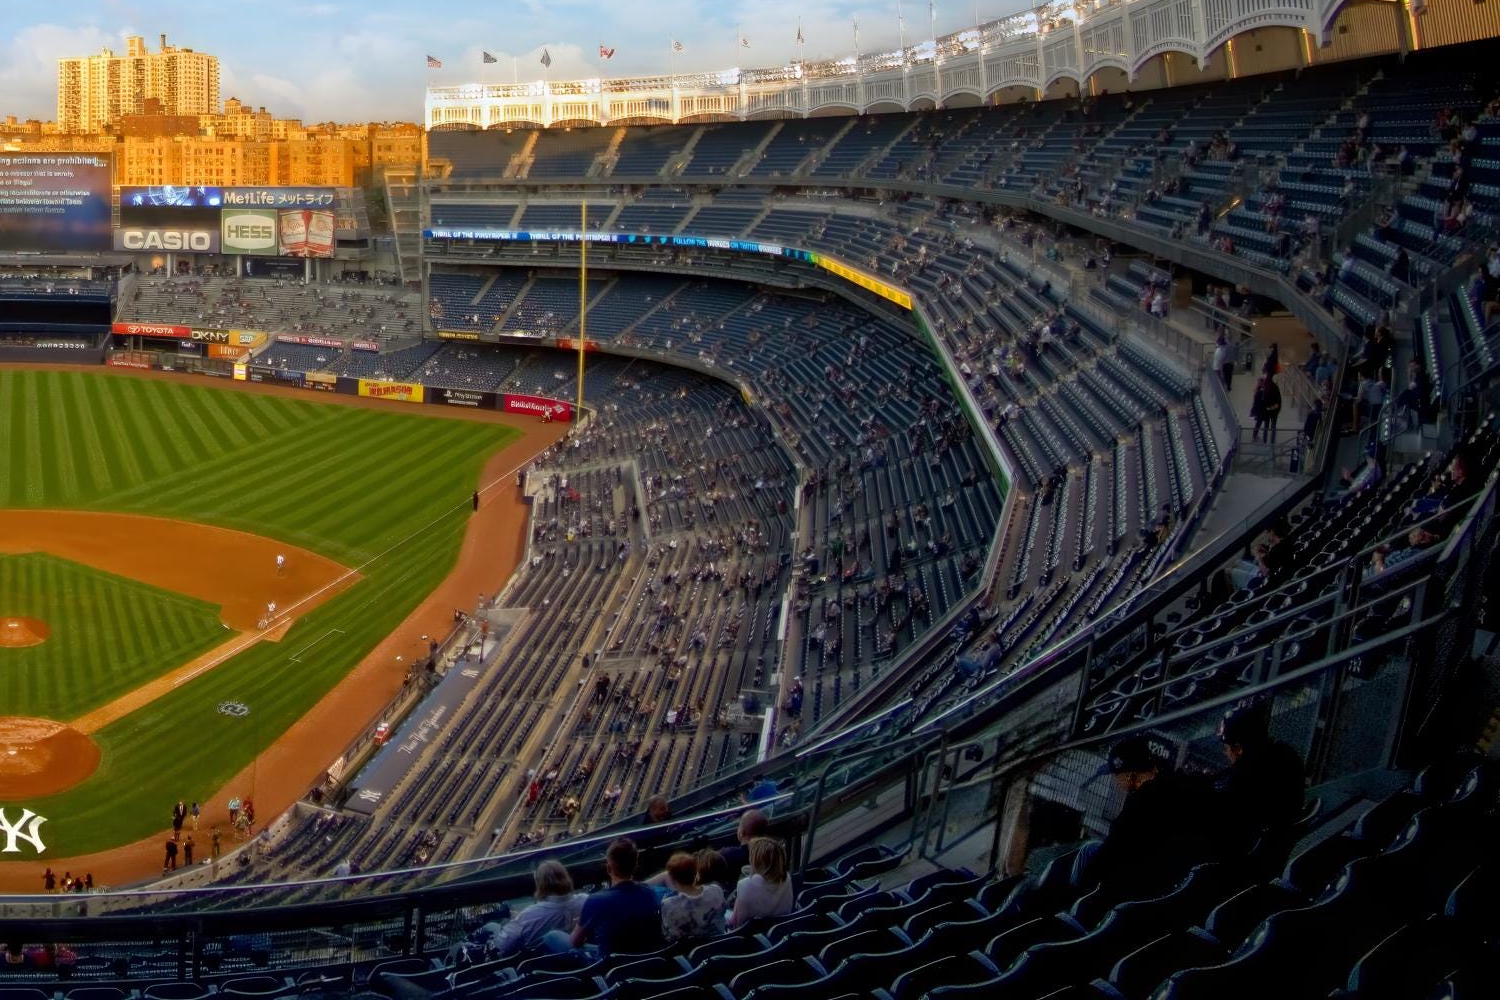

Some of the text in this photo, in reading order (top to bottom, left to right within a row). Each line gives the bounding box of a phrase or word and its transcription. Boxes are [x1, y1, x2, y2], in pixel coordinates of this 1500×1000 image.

[223, 191, 275, 205] MetLife
[278, 194, 334, 205] メットライフ
[227, 225, 273, 239] HESS
[123, 231, 211, 250] CASIO
[140, 326, 174, 335] TOYOTA
[191, 330, 229, 342] DKNY
